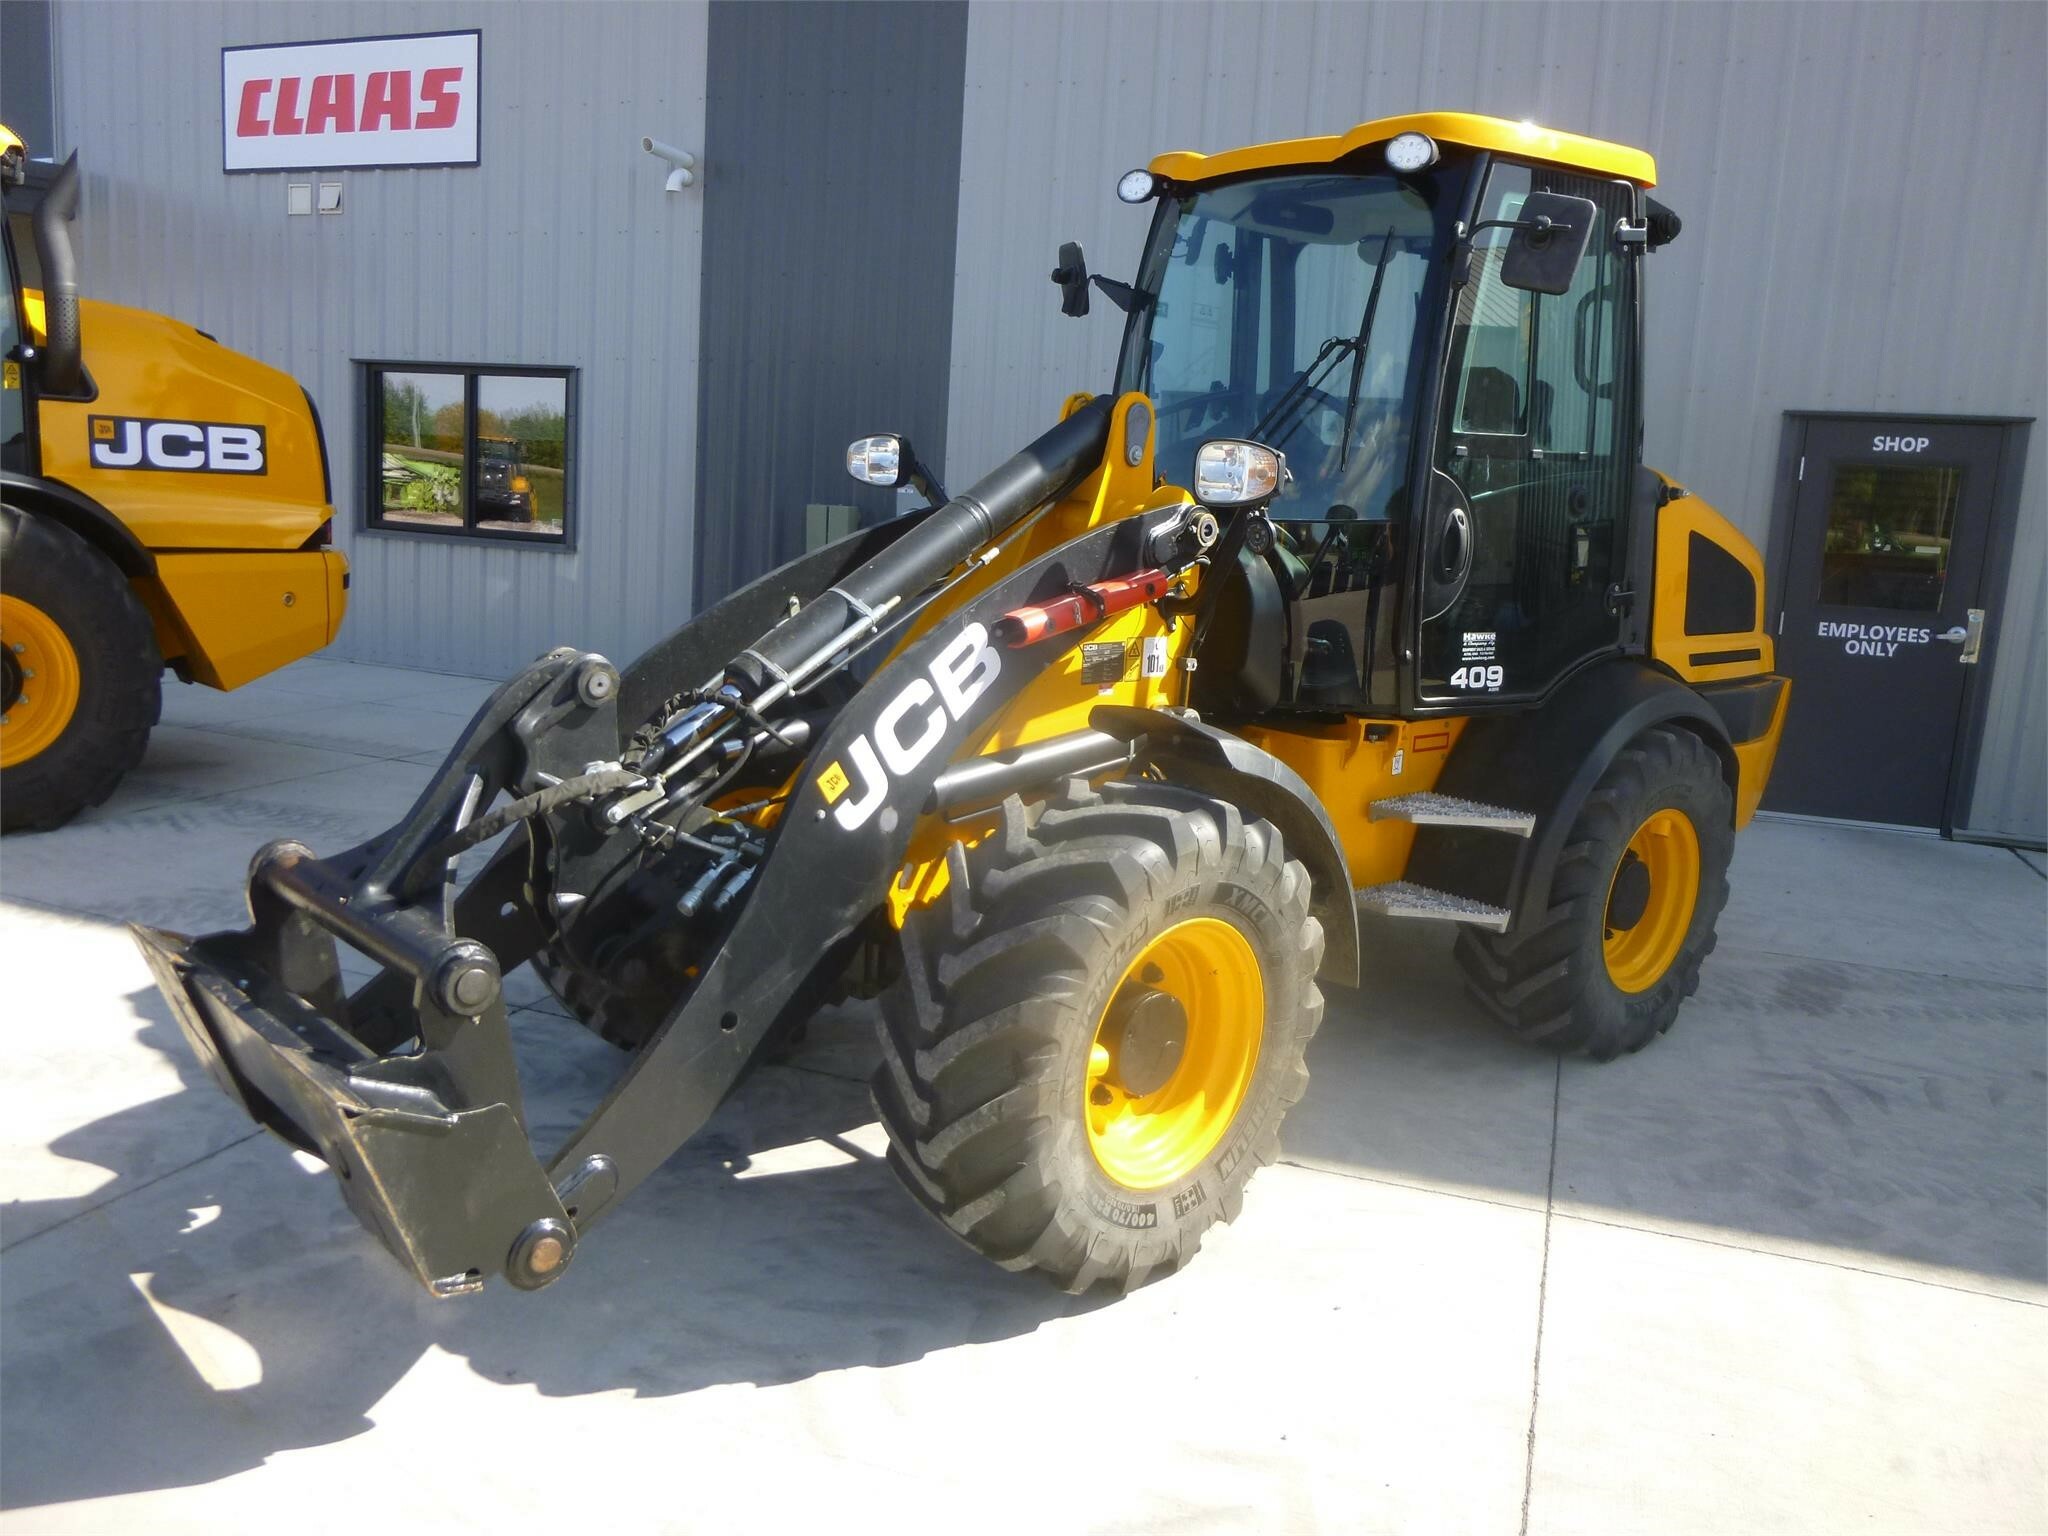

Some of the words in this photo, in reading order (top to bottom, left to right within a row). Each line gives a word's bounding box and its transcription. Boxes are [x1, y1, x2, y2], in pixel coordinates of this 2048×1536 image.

[237, 67, 463, 137] CLAAS
[95, 421, 264, 471] JCB
[1873, 436, 1929, 452] SHOP
[1463, 632, 1496, 640] Hawke
[1818, 622, 1930, 643] EMPLOYEES
[1845, 640, 1898, 657] ONLY
[1450, 665, 1503, 688] 409
[834, 622, 1001, 830] JCB
